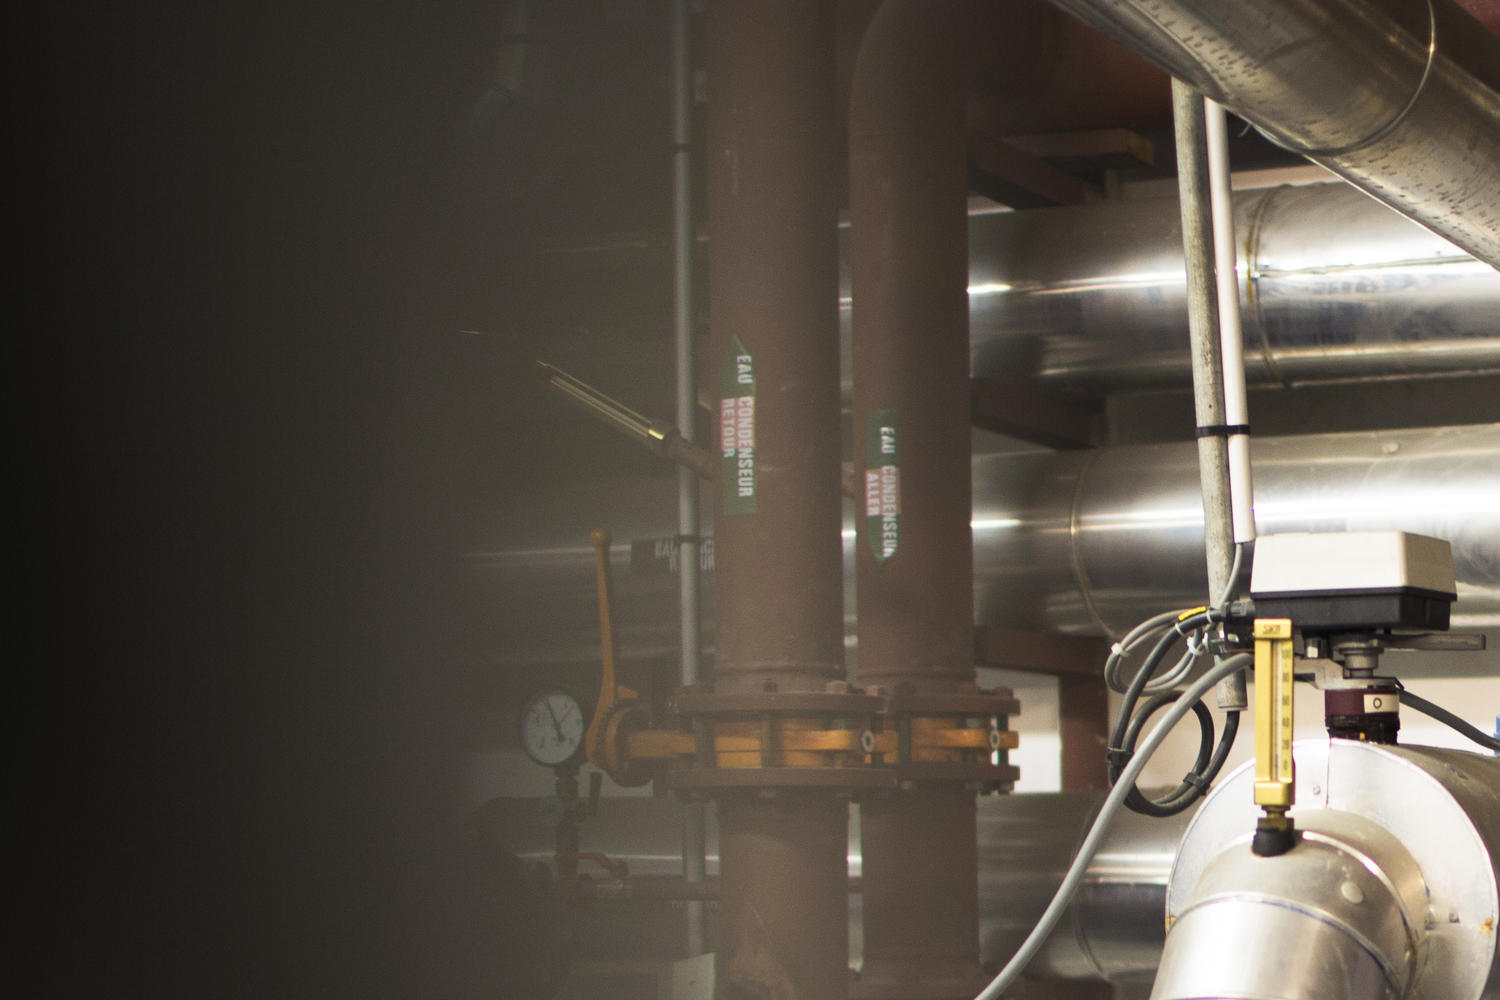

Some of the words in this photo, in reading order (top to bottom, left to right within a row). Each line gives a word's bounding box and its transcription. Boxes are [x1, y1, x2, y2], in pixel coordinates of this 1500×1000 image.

[736, 355, 753, 385] EAU
[722, 398, 736, 458] RETOUR
[737, 397, 754, 497] CONDENSEUR
[879, 426, 895, 454] EAU
[866, 473, 880, 517] ALLER
